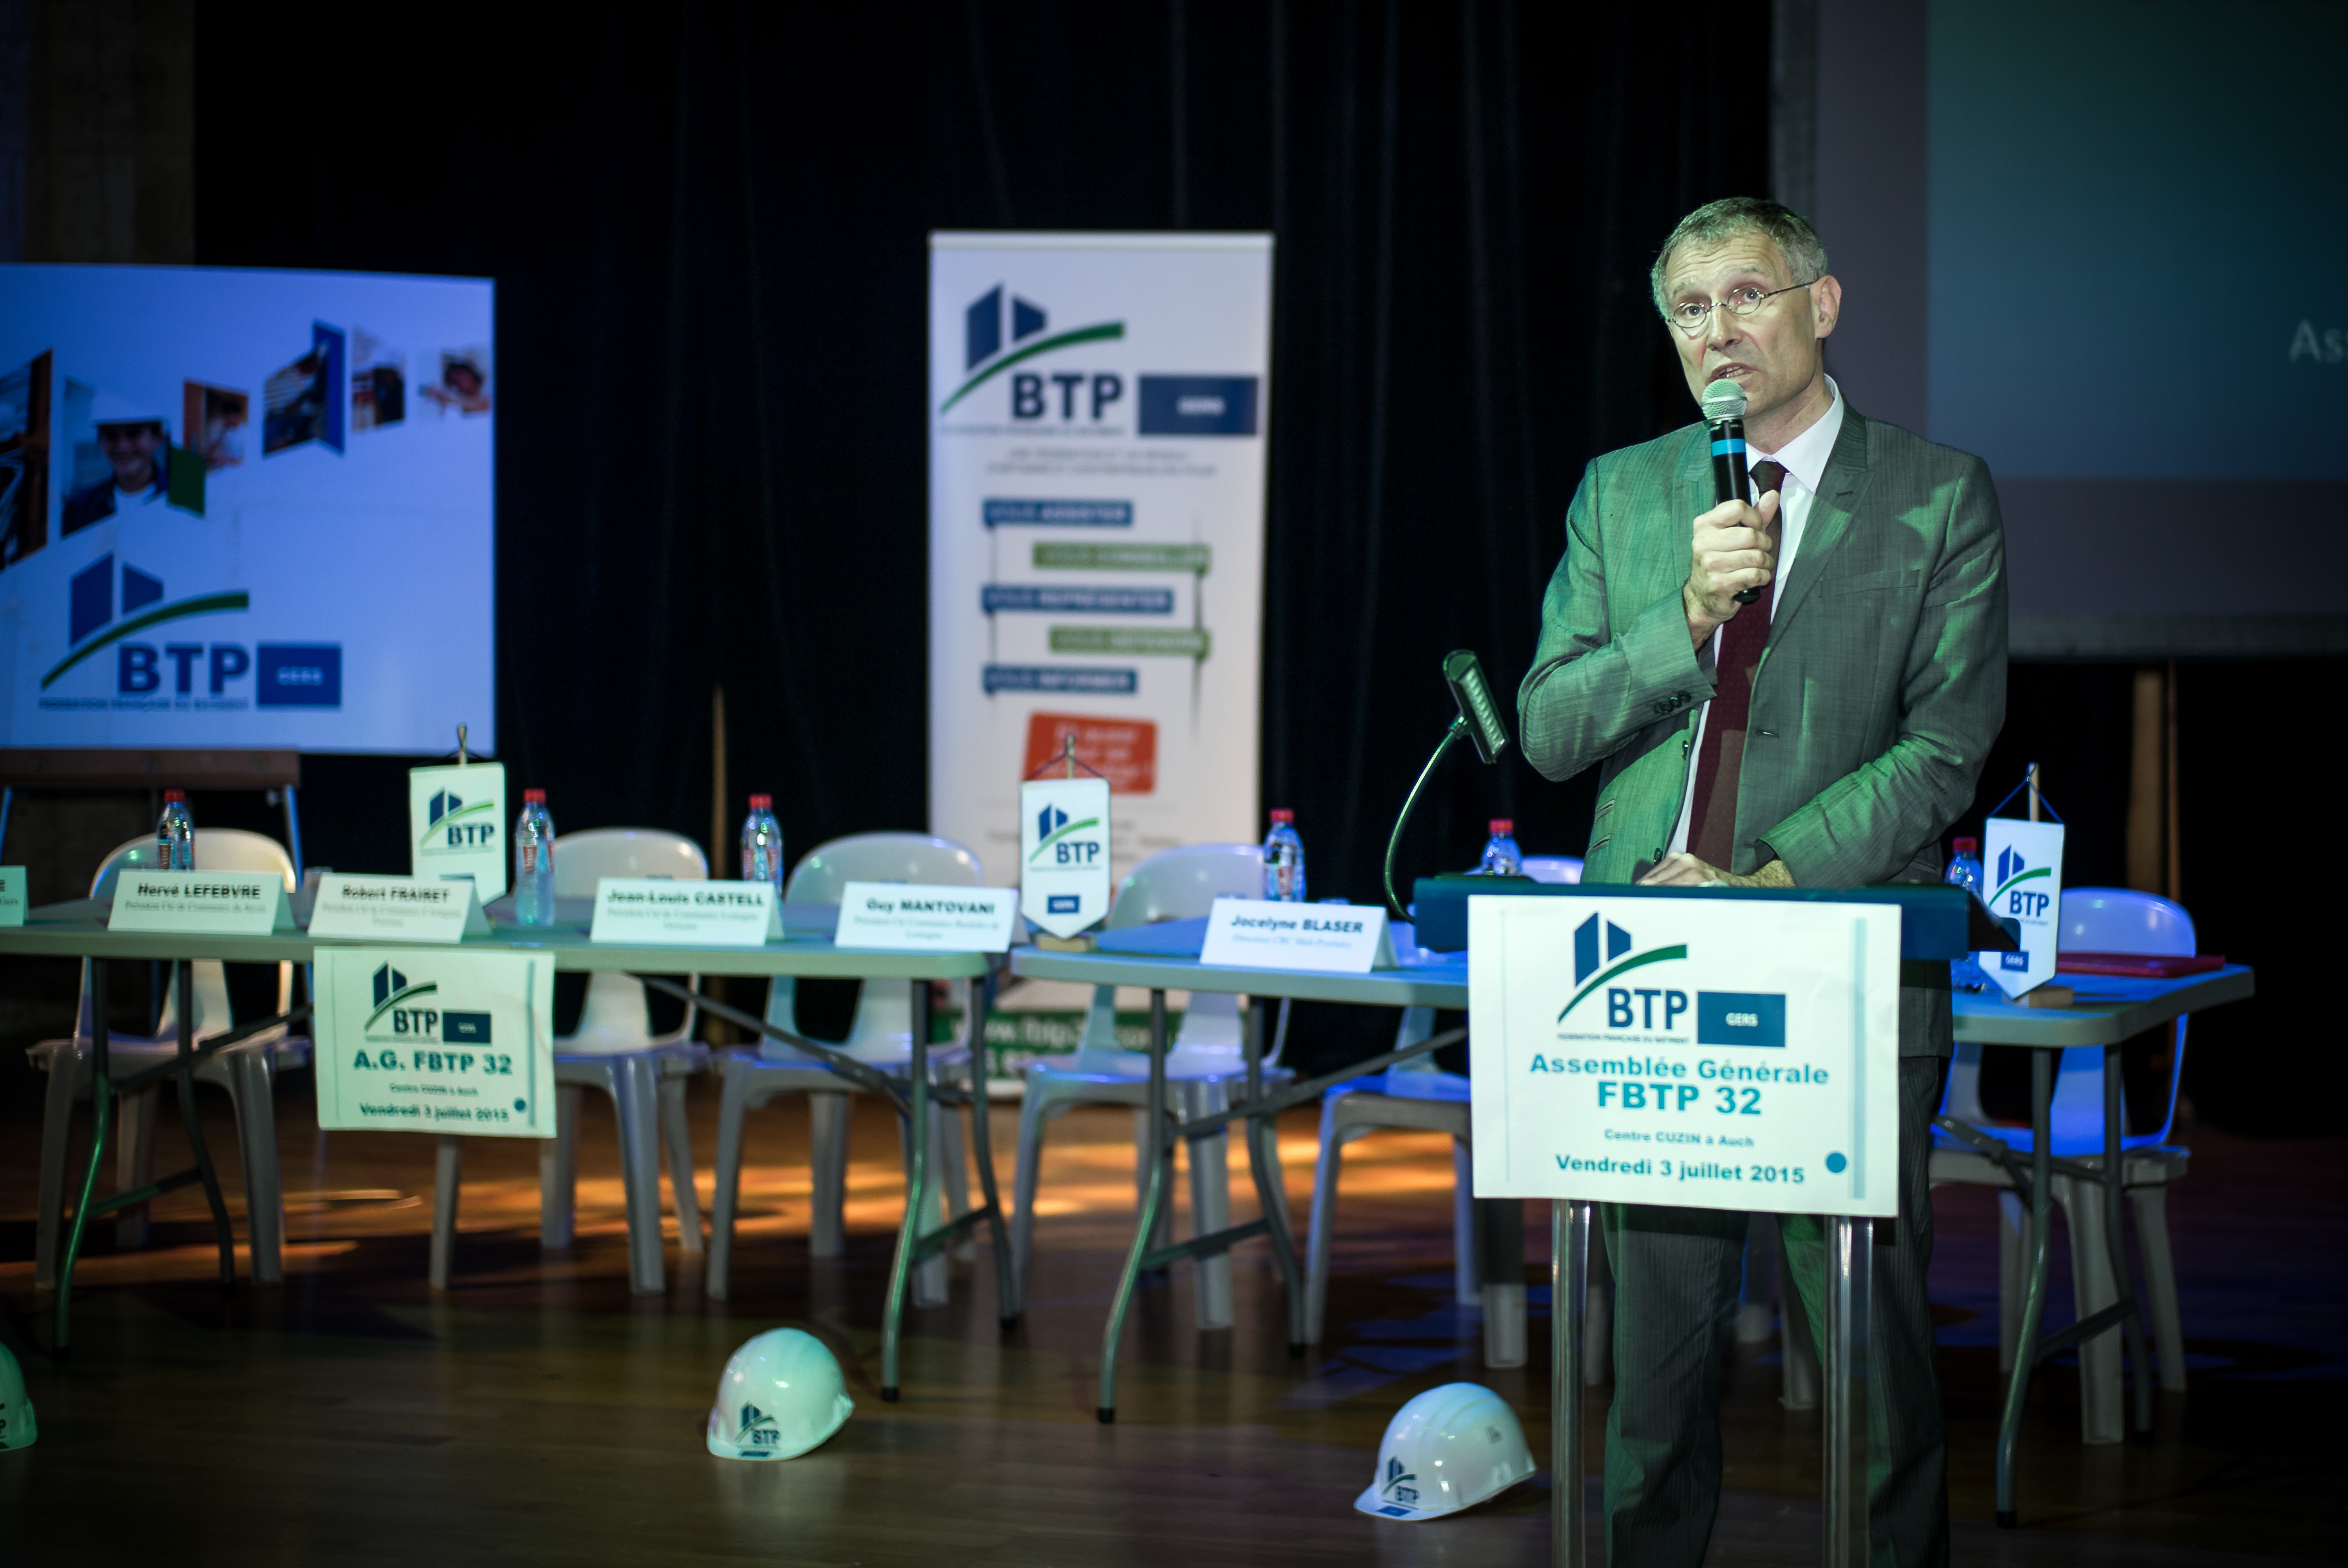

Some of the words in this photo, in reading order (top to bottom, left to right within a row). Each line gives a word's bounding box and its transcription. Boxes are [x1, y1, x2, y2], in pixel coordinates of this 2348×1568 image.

[2290, 319, 2348, 363] As
[1011, 372, 1124, 420] BTP
[119, 642, 250, 694] BTP
[448, 823, 495, 847] BTP
[1056, 841, 1100, 864] BTP
[138, 883, 179, 897] Hervé
[184, 884, 261, 899] LEFEBVRE
[342, 885, 386, 901] Robert
[608, 889, 689, 905] Jean-Louis
[695, 892, 765, 907] CASTELL
[2010, 890, 2049, 917] BTP
[866, 898, 895, 914] Guy
[900, 899, 994, 914] MANTOVANI
[1231, 916, 1297, 931] Jocelyne
[1303, 919, 1363, 933] BLASER
[1608, 987, 1688, 1030] BTP
[1725, 1012, 1759, 1027] GERS
[393, 1007, 438, 1036] BTP
[353, 1049, 406, 1071] A.G.
[413, 1049, 475, 1074] FBTP
[482, 1053, 513, 1076] 32
[1530, 1053, 1687, 1077] Assemblée
[1697, 1058, 1829, 1085] Générale
[1598, 1081, 1699, 1111] FBTP
[1715, 1086, 1762, 1115] 32
[359, 1102, 421, 1117] Vendredi
[423, 1103, 431, 1118] 3
[434, 1105, 472, 1121] juillet
[1604, 1128, 1651, 1141] Centre
[1655, 1130, 1701, 1144] CUZIN
[1705, 1132, 1714, 1145] à
[1718, 1134, 1754, 1147] Auch
[1555, 1153, 1652, 1175] Vendredi
[1660, 1159, 1672, 1177] 3
[1678, 1160, 1743, 1182] juillet
[1750, 1164, 1805, 1184] 2015
